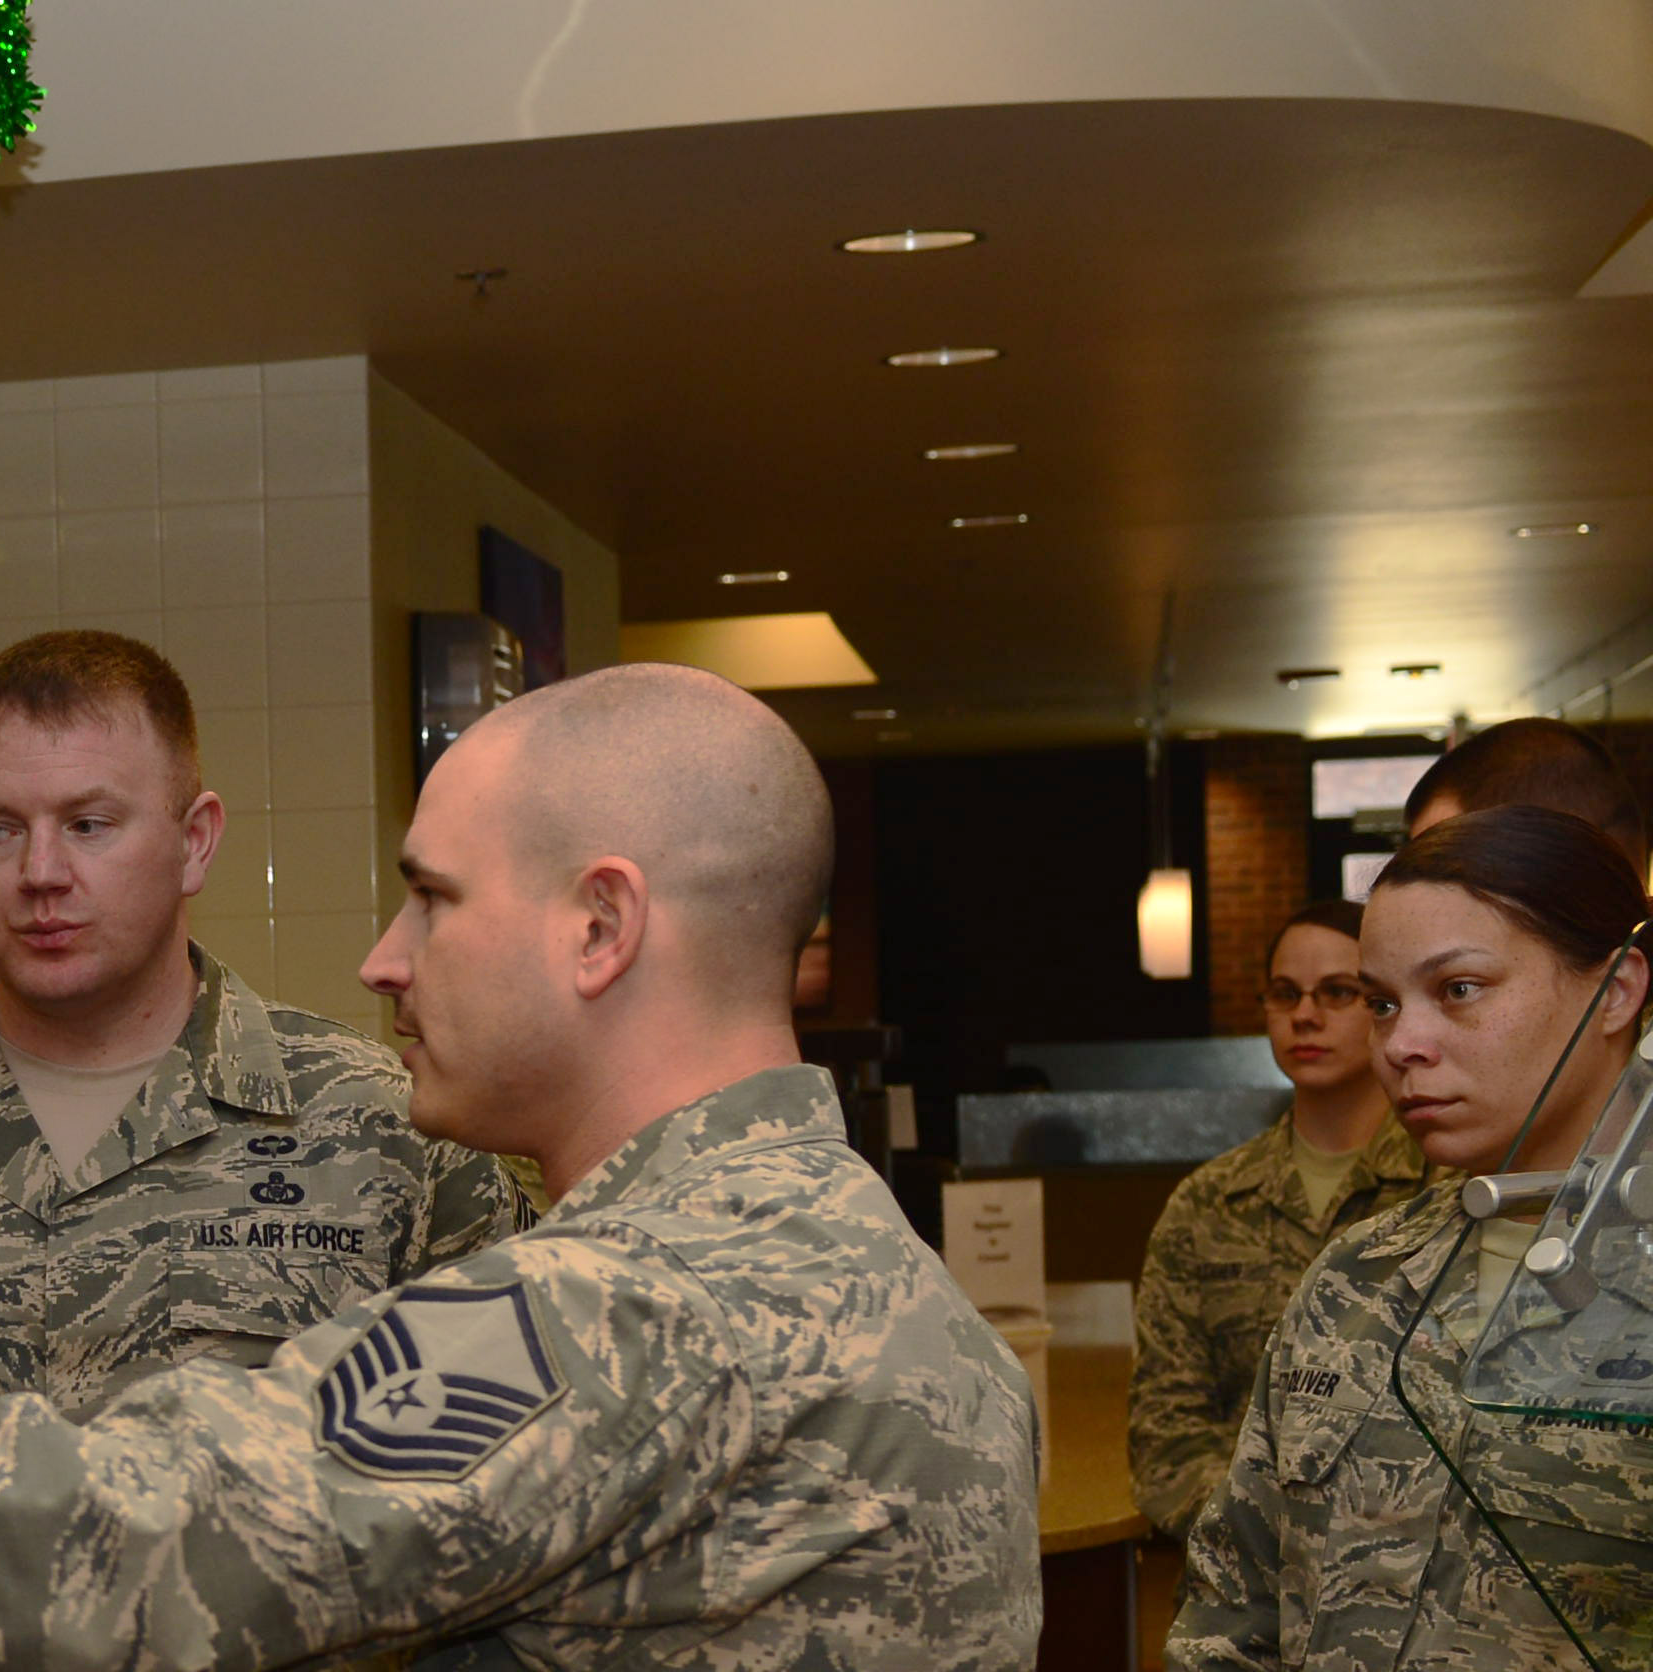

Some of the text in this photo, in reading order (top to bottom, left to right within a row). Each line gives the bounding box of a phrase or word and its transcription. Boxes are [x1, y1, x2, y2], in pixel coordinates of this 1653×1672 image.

[200, 1223, 365, 1254] U.S. AIR FORCE
